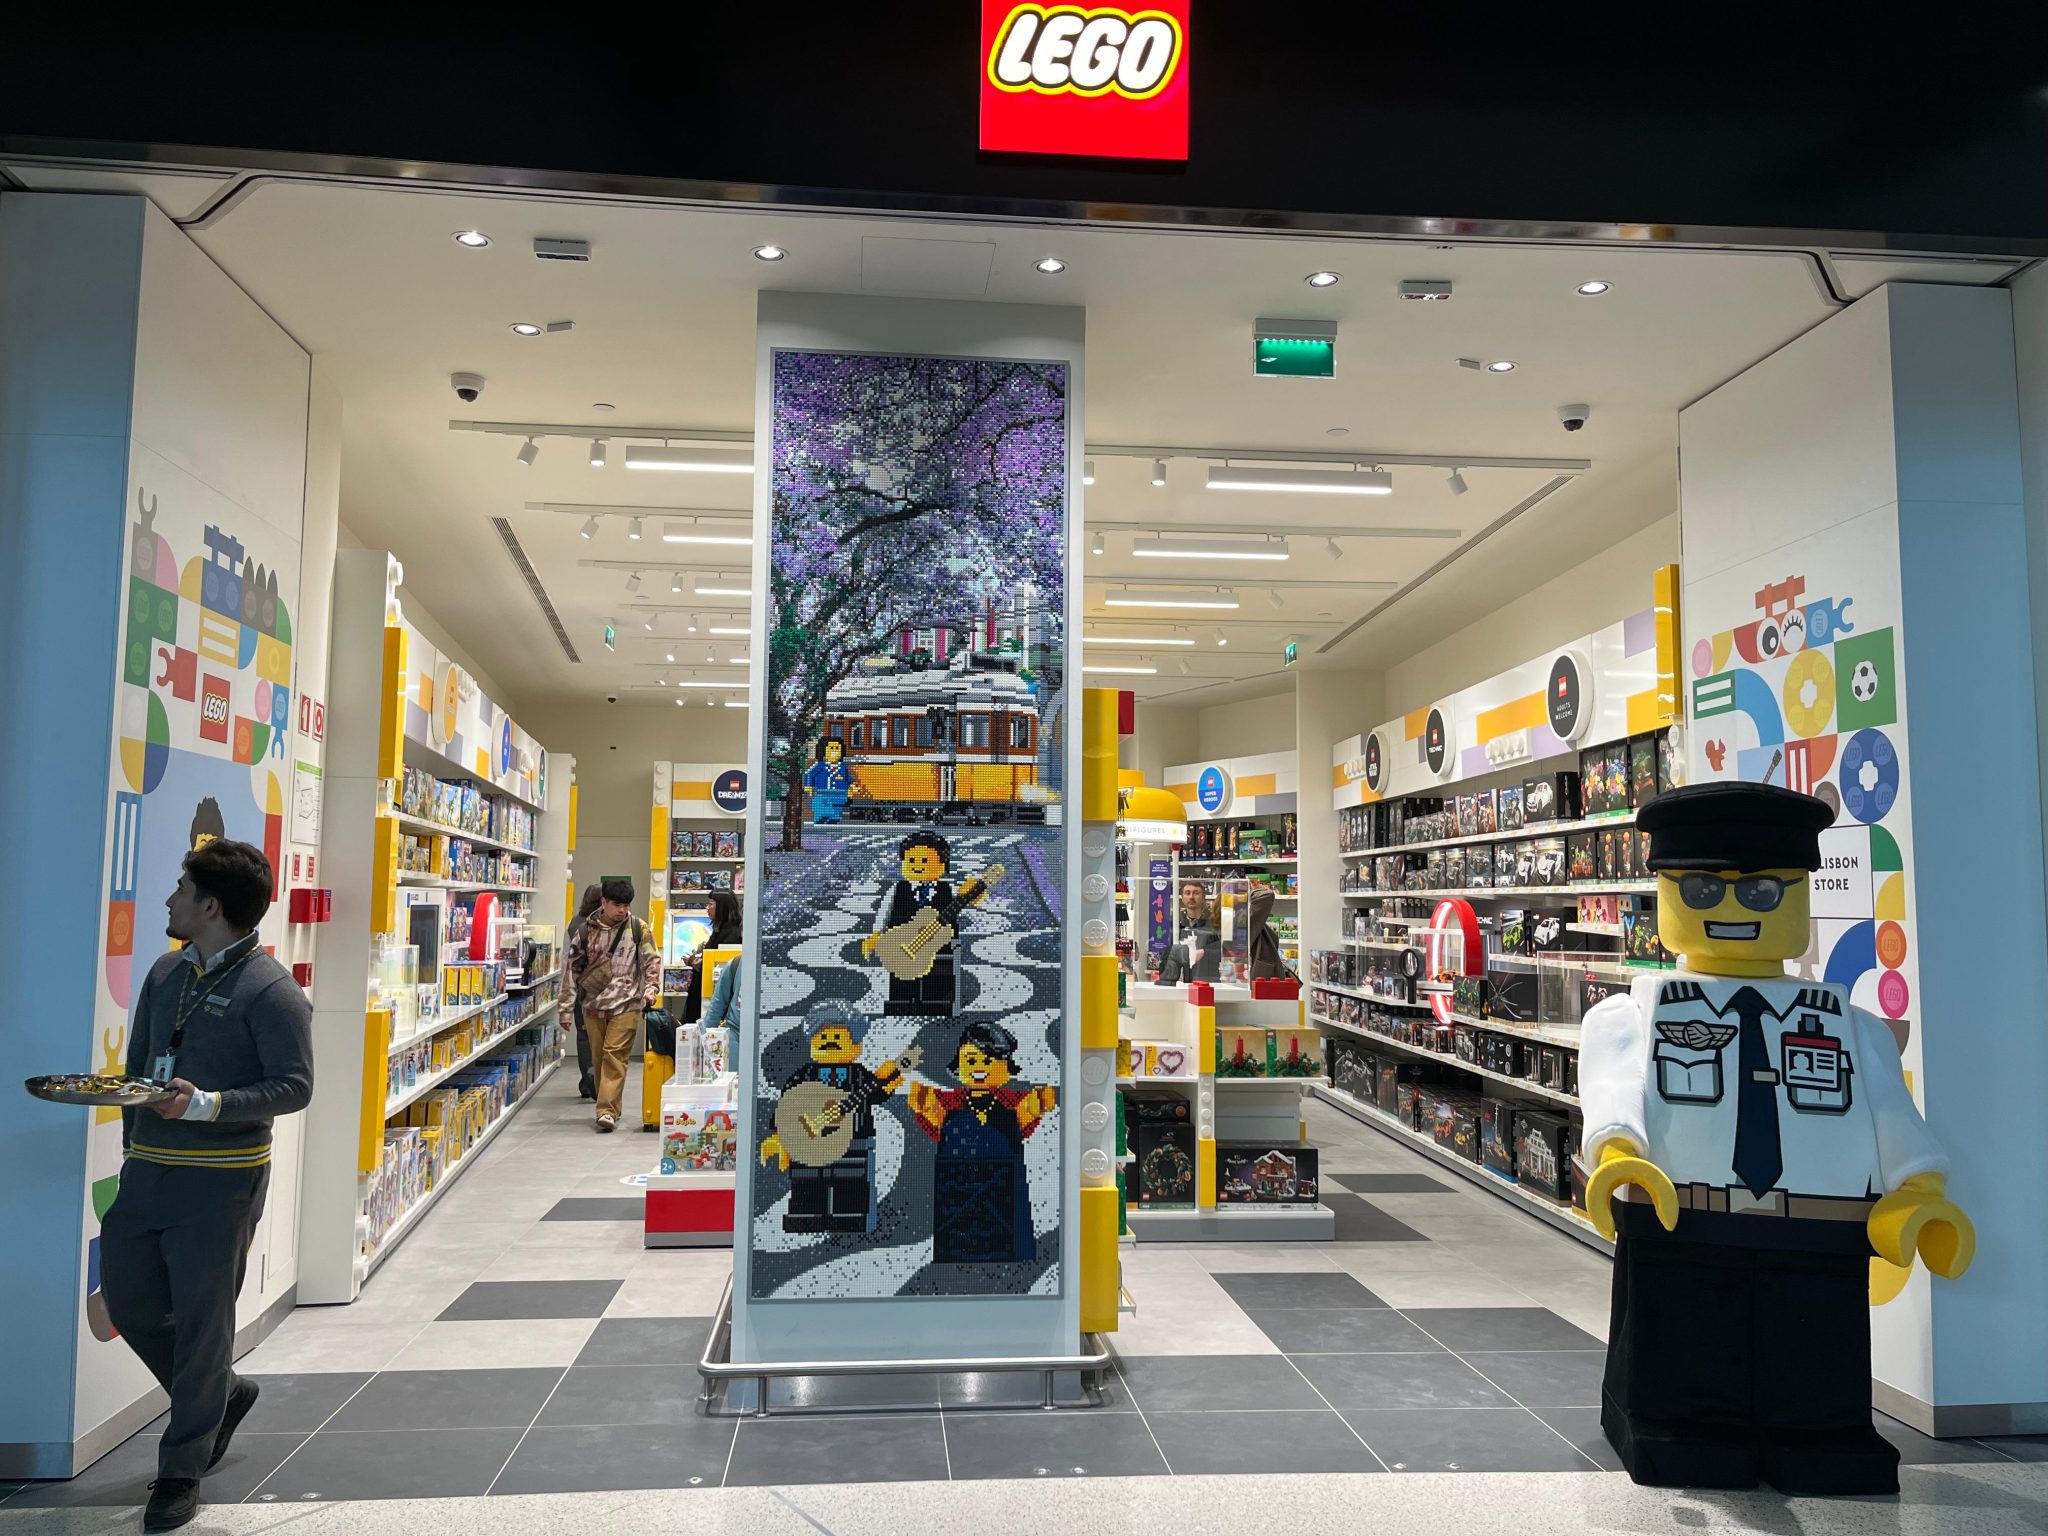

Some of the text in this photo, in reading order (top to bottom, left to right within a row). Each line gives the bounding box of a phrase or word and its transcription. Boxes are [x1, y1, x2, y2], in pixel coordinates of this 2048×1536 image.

[997, 12, 1174, 92] LEGO
[202, 694, 228, 724] LEGO
[1556, 702, 1571, 712] ADULTS
[1555, 709, 1573, 720] WELCOME
[1814, 878, 1849, 891] STORE
[662, 1162, 673, 1171] 2+
